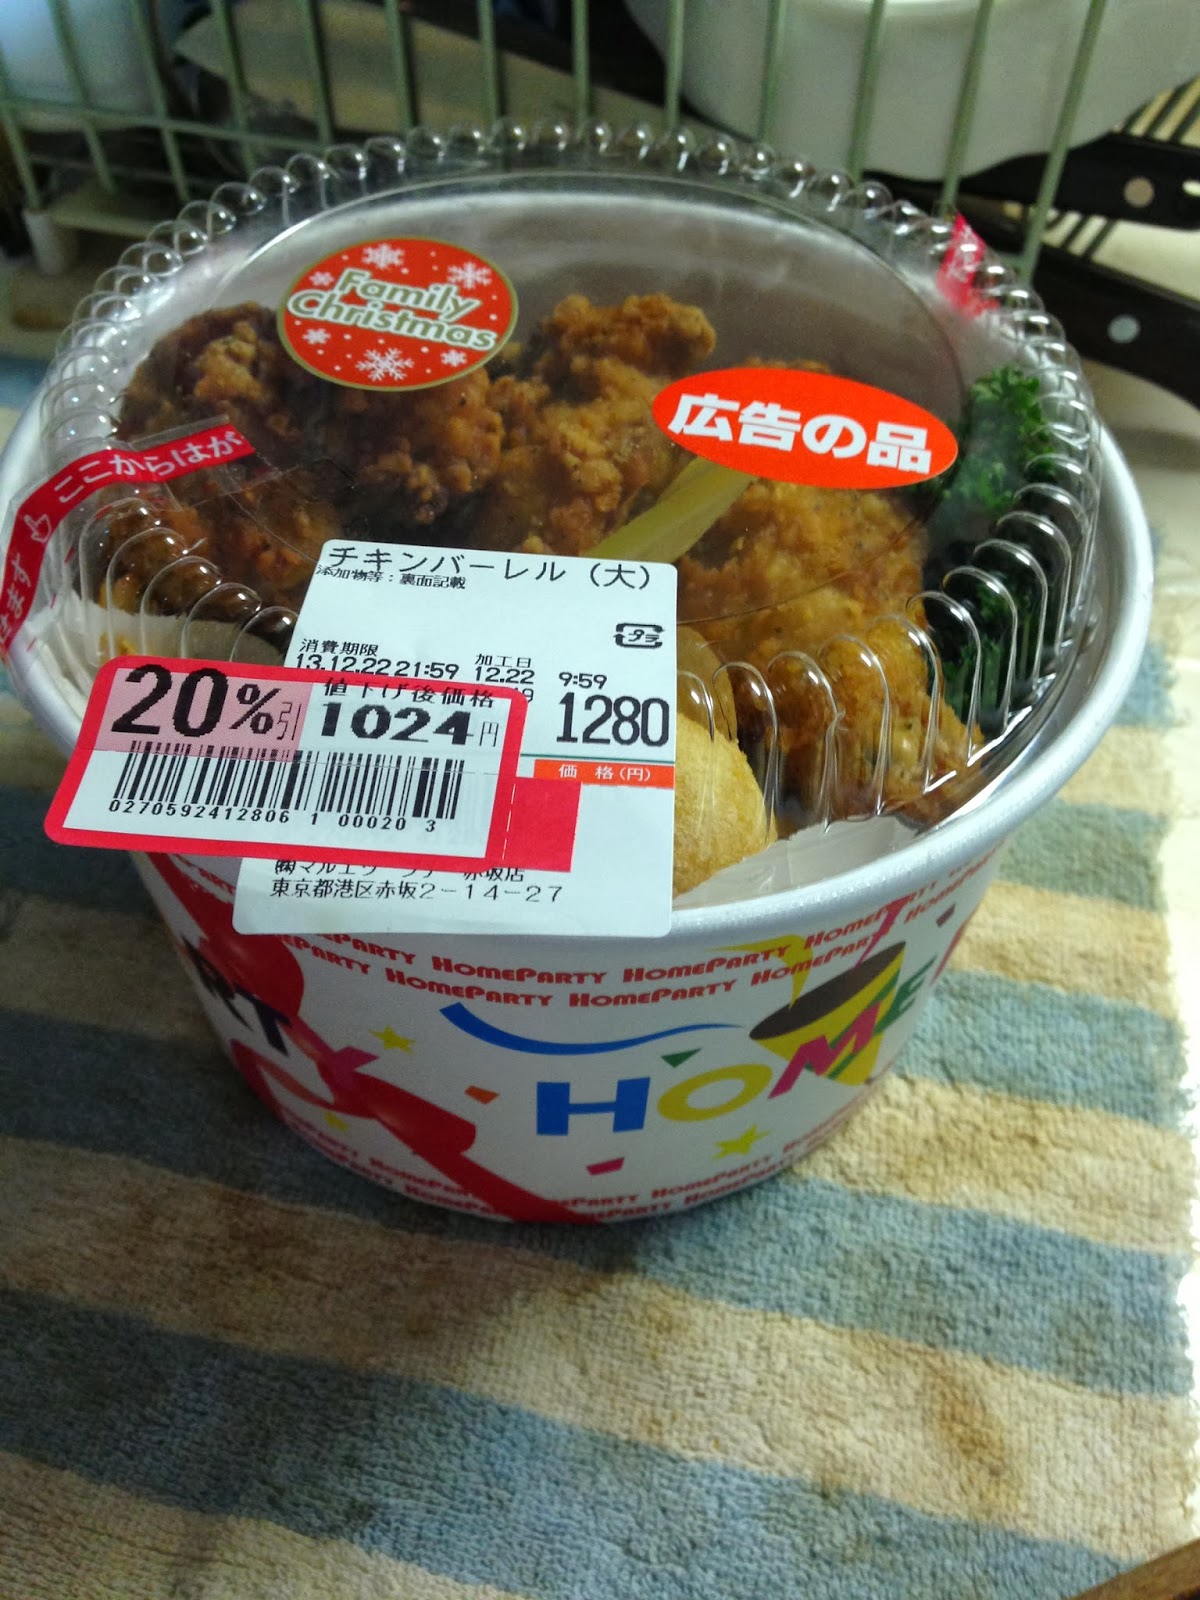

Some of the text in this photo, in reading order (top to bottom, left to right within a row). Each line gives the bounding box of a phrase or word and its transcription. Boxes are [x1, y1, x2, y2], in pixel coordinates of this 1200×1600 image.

[333, 267, 482, 324] Family
[287, 289, 498, 351] Christmas
[668, 392, 932, 474] 広告の品
[299, 638, 379, 657] 消費期限
[474, 653, 532, 669] 加工日
[474, 665, 536, 685] 12.22
[558, 671, 608, 690] 9:59
[556, 692, 670, 747] 1280
[109, 800, 290, 824] 0270592412806
[338, 815, 407, 831] 00020
